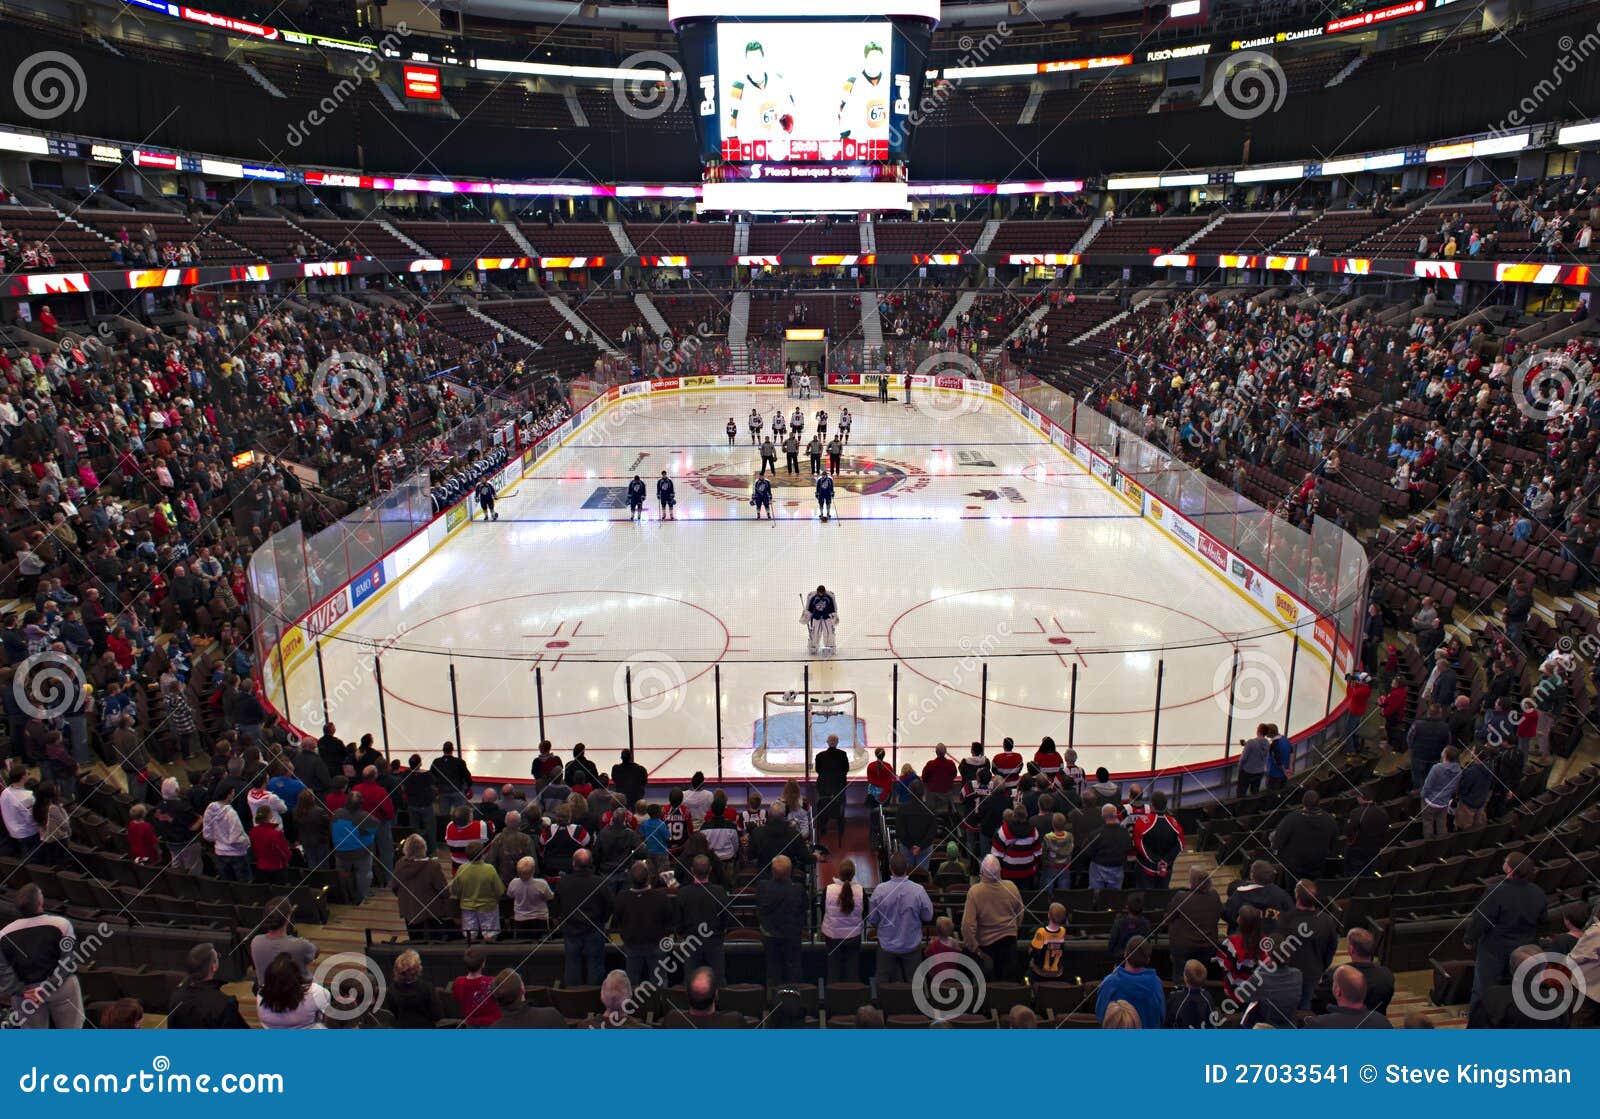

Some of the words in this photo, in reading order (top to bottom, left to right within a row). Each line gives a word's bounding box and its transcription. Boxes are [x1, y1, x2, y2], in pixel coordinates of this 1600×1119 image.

[1240, 36, 1275, 49] CAMBRIA
[1286, 26, 1324, 41] CAMBRIA
[355, 579, 371, 597] BMO
[1276, 596, 1297, 619] Denny's
[310, 603, 337, 635] AVIS
